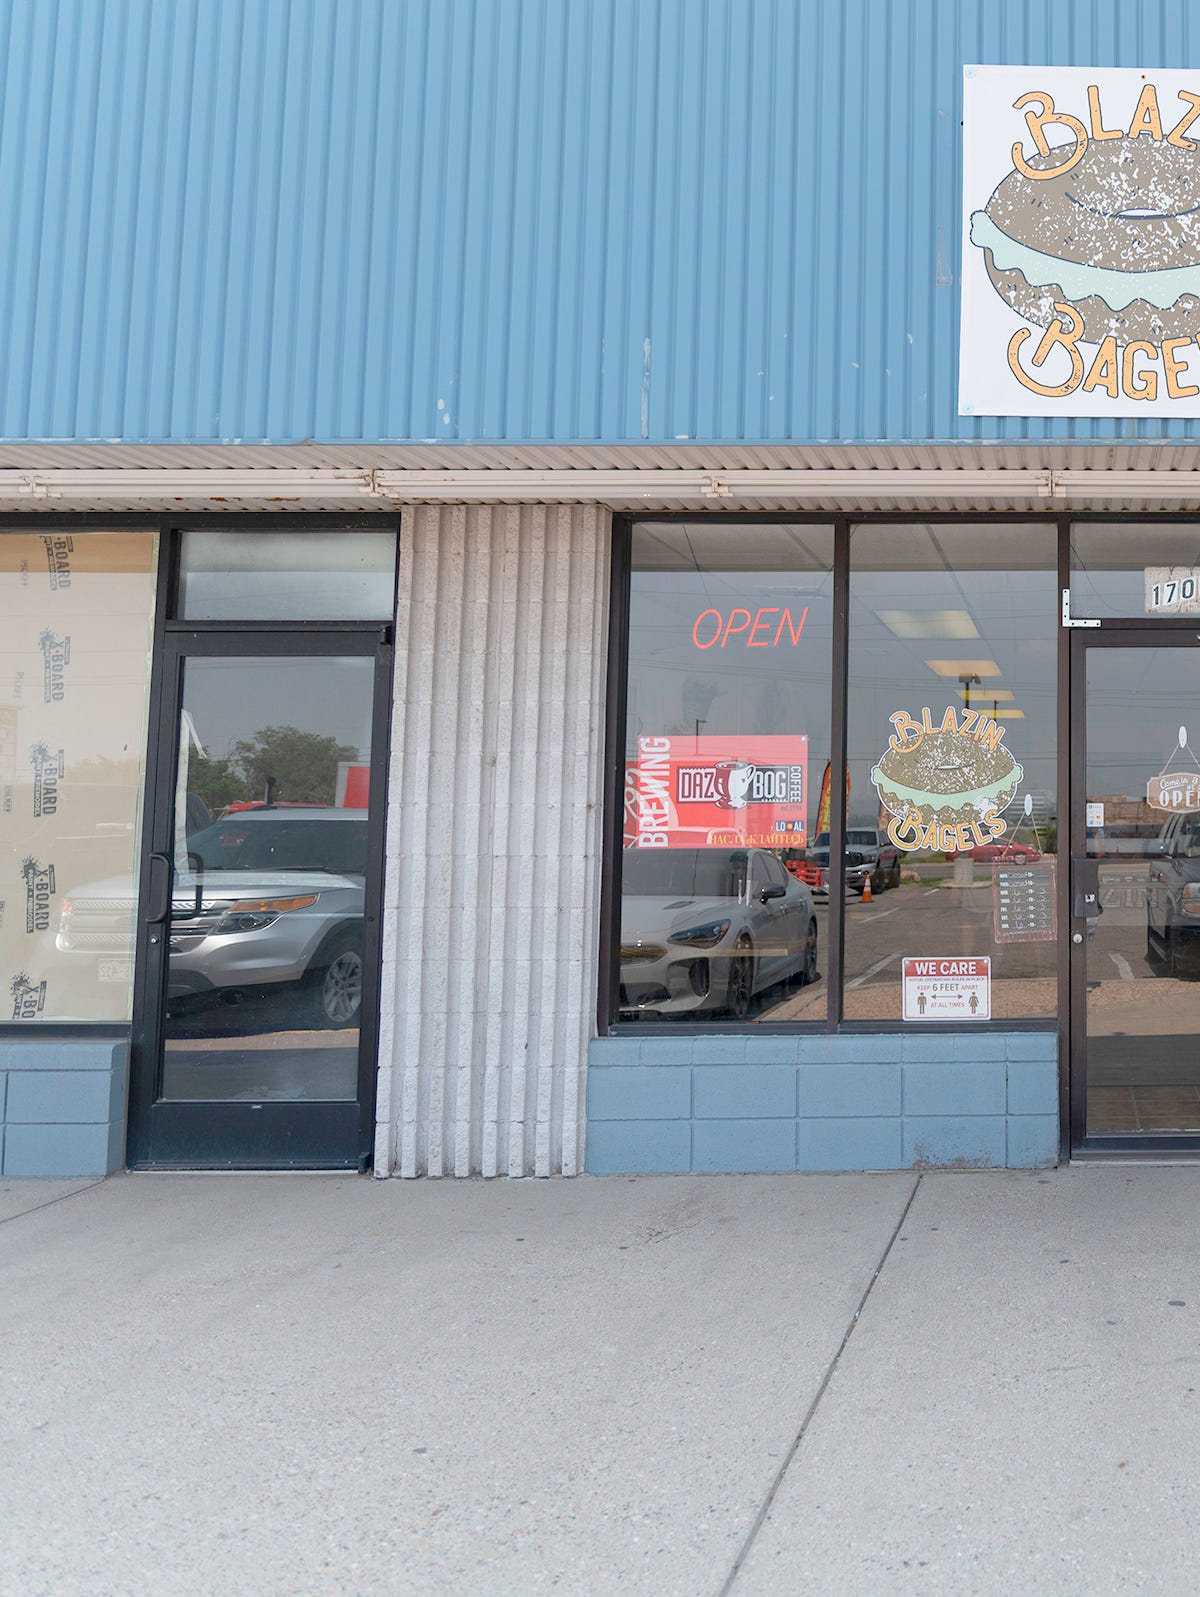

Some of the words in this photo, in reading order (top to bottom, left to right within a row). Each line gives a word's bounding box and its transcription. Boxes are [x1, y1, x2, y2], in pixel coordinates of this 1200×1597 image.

[693, 607, 808, 649] OPEN
[889, 706, 1005, 753] BLAZIN
[638, 737, 671, 847] BREWING
[790, 767, 802, 803] COFFEE
[888, 808, 1007, 851] BAGELS
[915, 962, 937, 975] WE
[940, 961, 976, 975] CARE
[932, 983, 938, 991] 6
[940, 983, 959, 991] FEET
